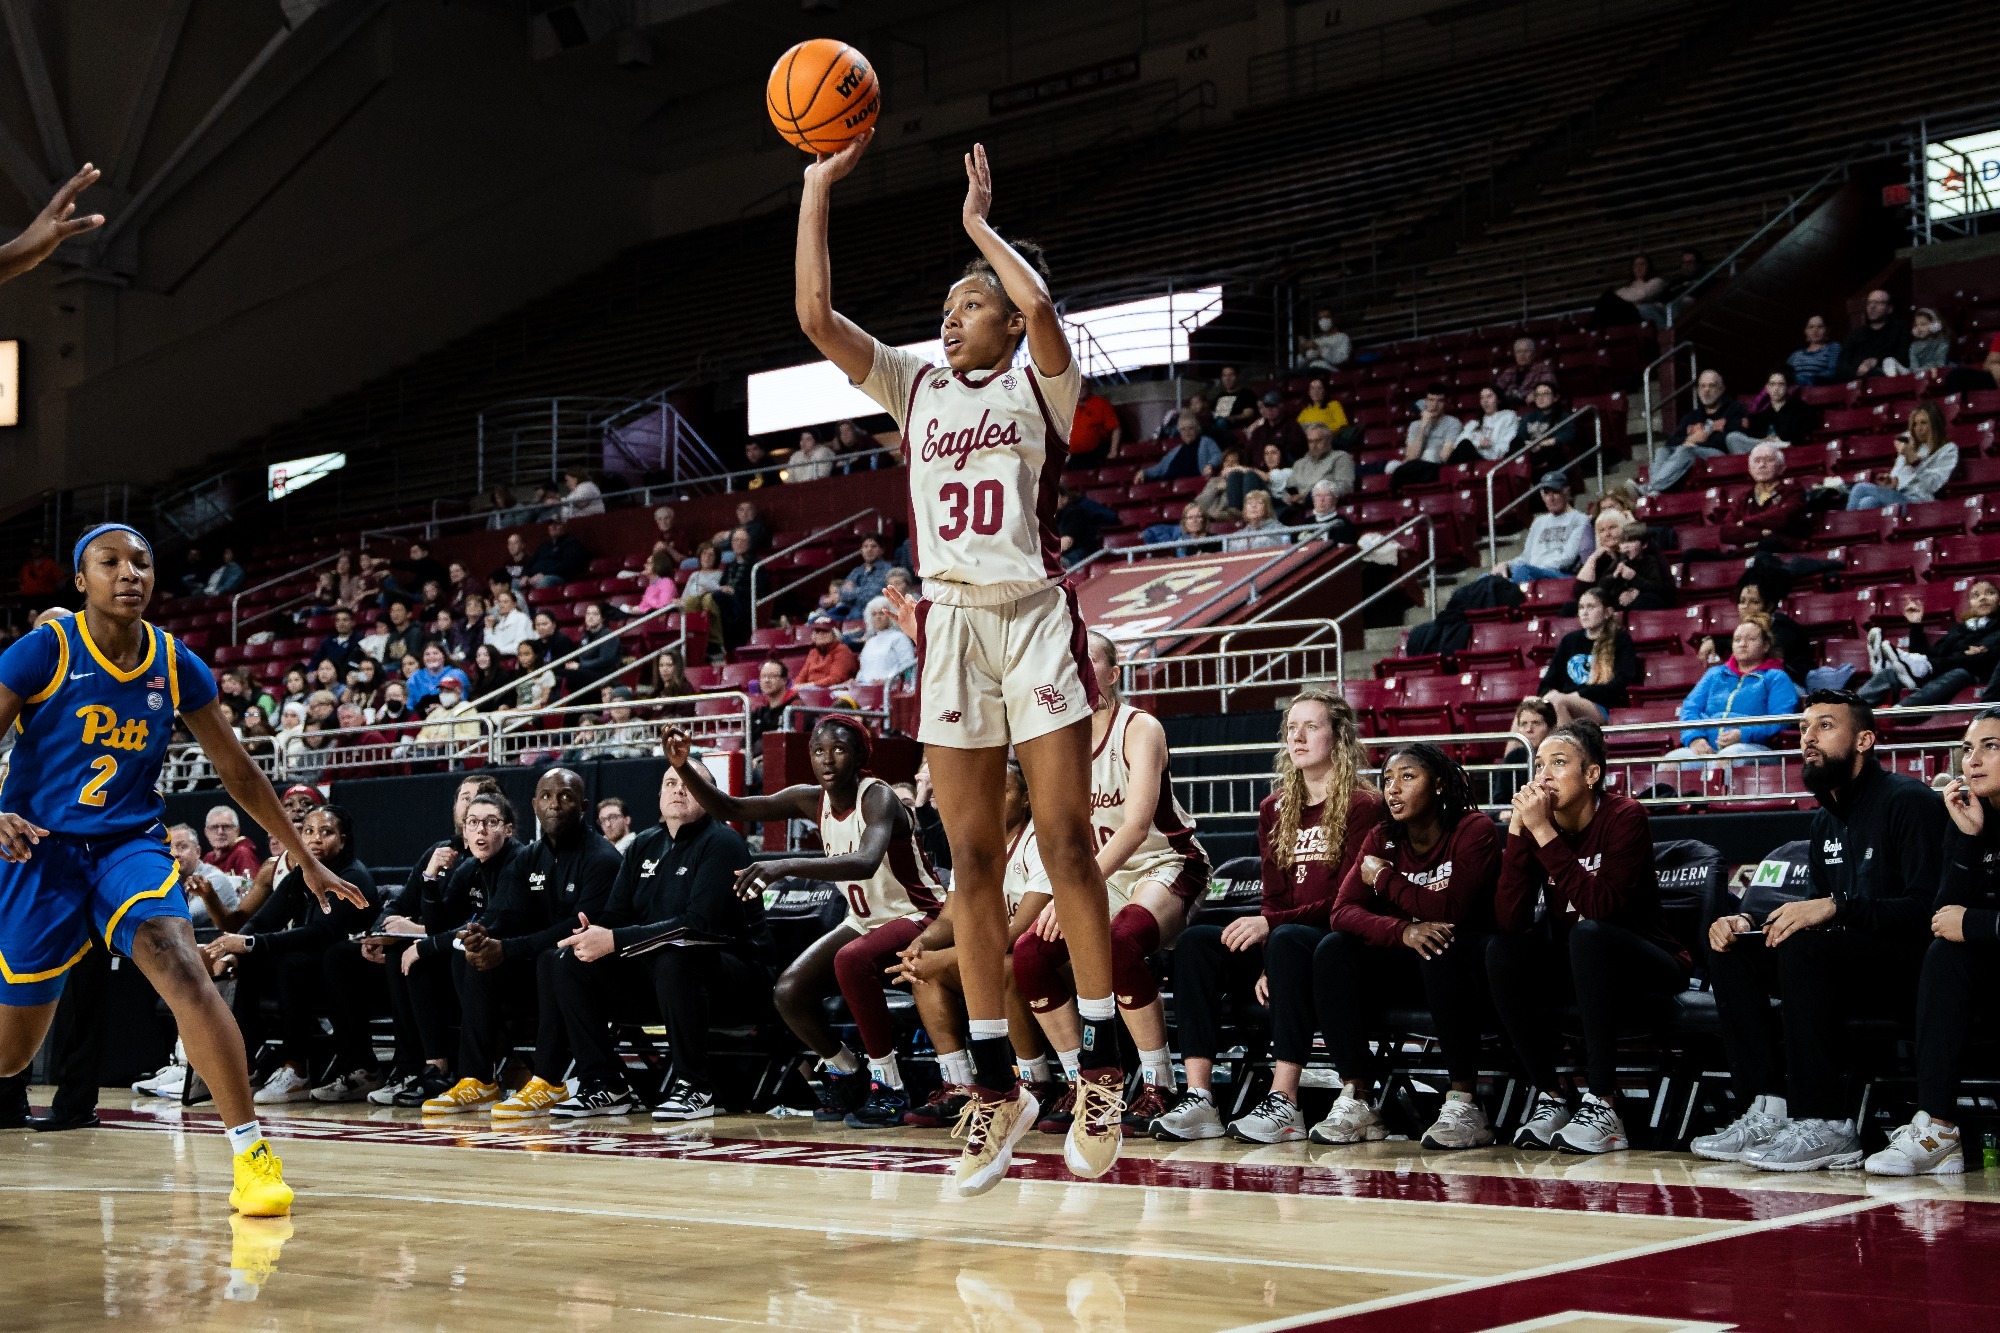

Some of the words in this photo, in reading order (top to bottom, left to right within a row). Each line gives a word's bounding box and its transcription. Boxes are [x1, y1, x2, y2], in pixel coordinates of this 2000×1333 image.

[836, 61, 867, 98] CAA
[921, 408, 1022, 471] Eagles
[938, 478, 1005, 541] 30
[75, 704, 149, 751] Pitt
[78, 754, 118, 807] 2
[1401, 861, 1453, 886] AGLES
[1758, 864, 1782, 883] M
[848, 884, 871, 918] 0
